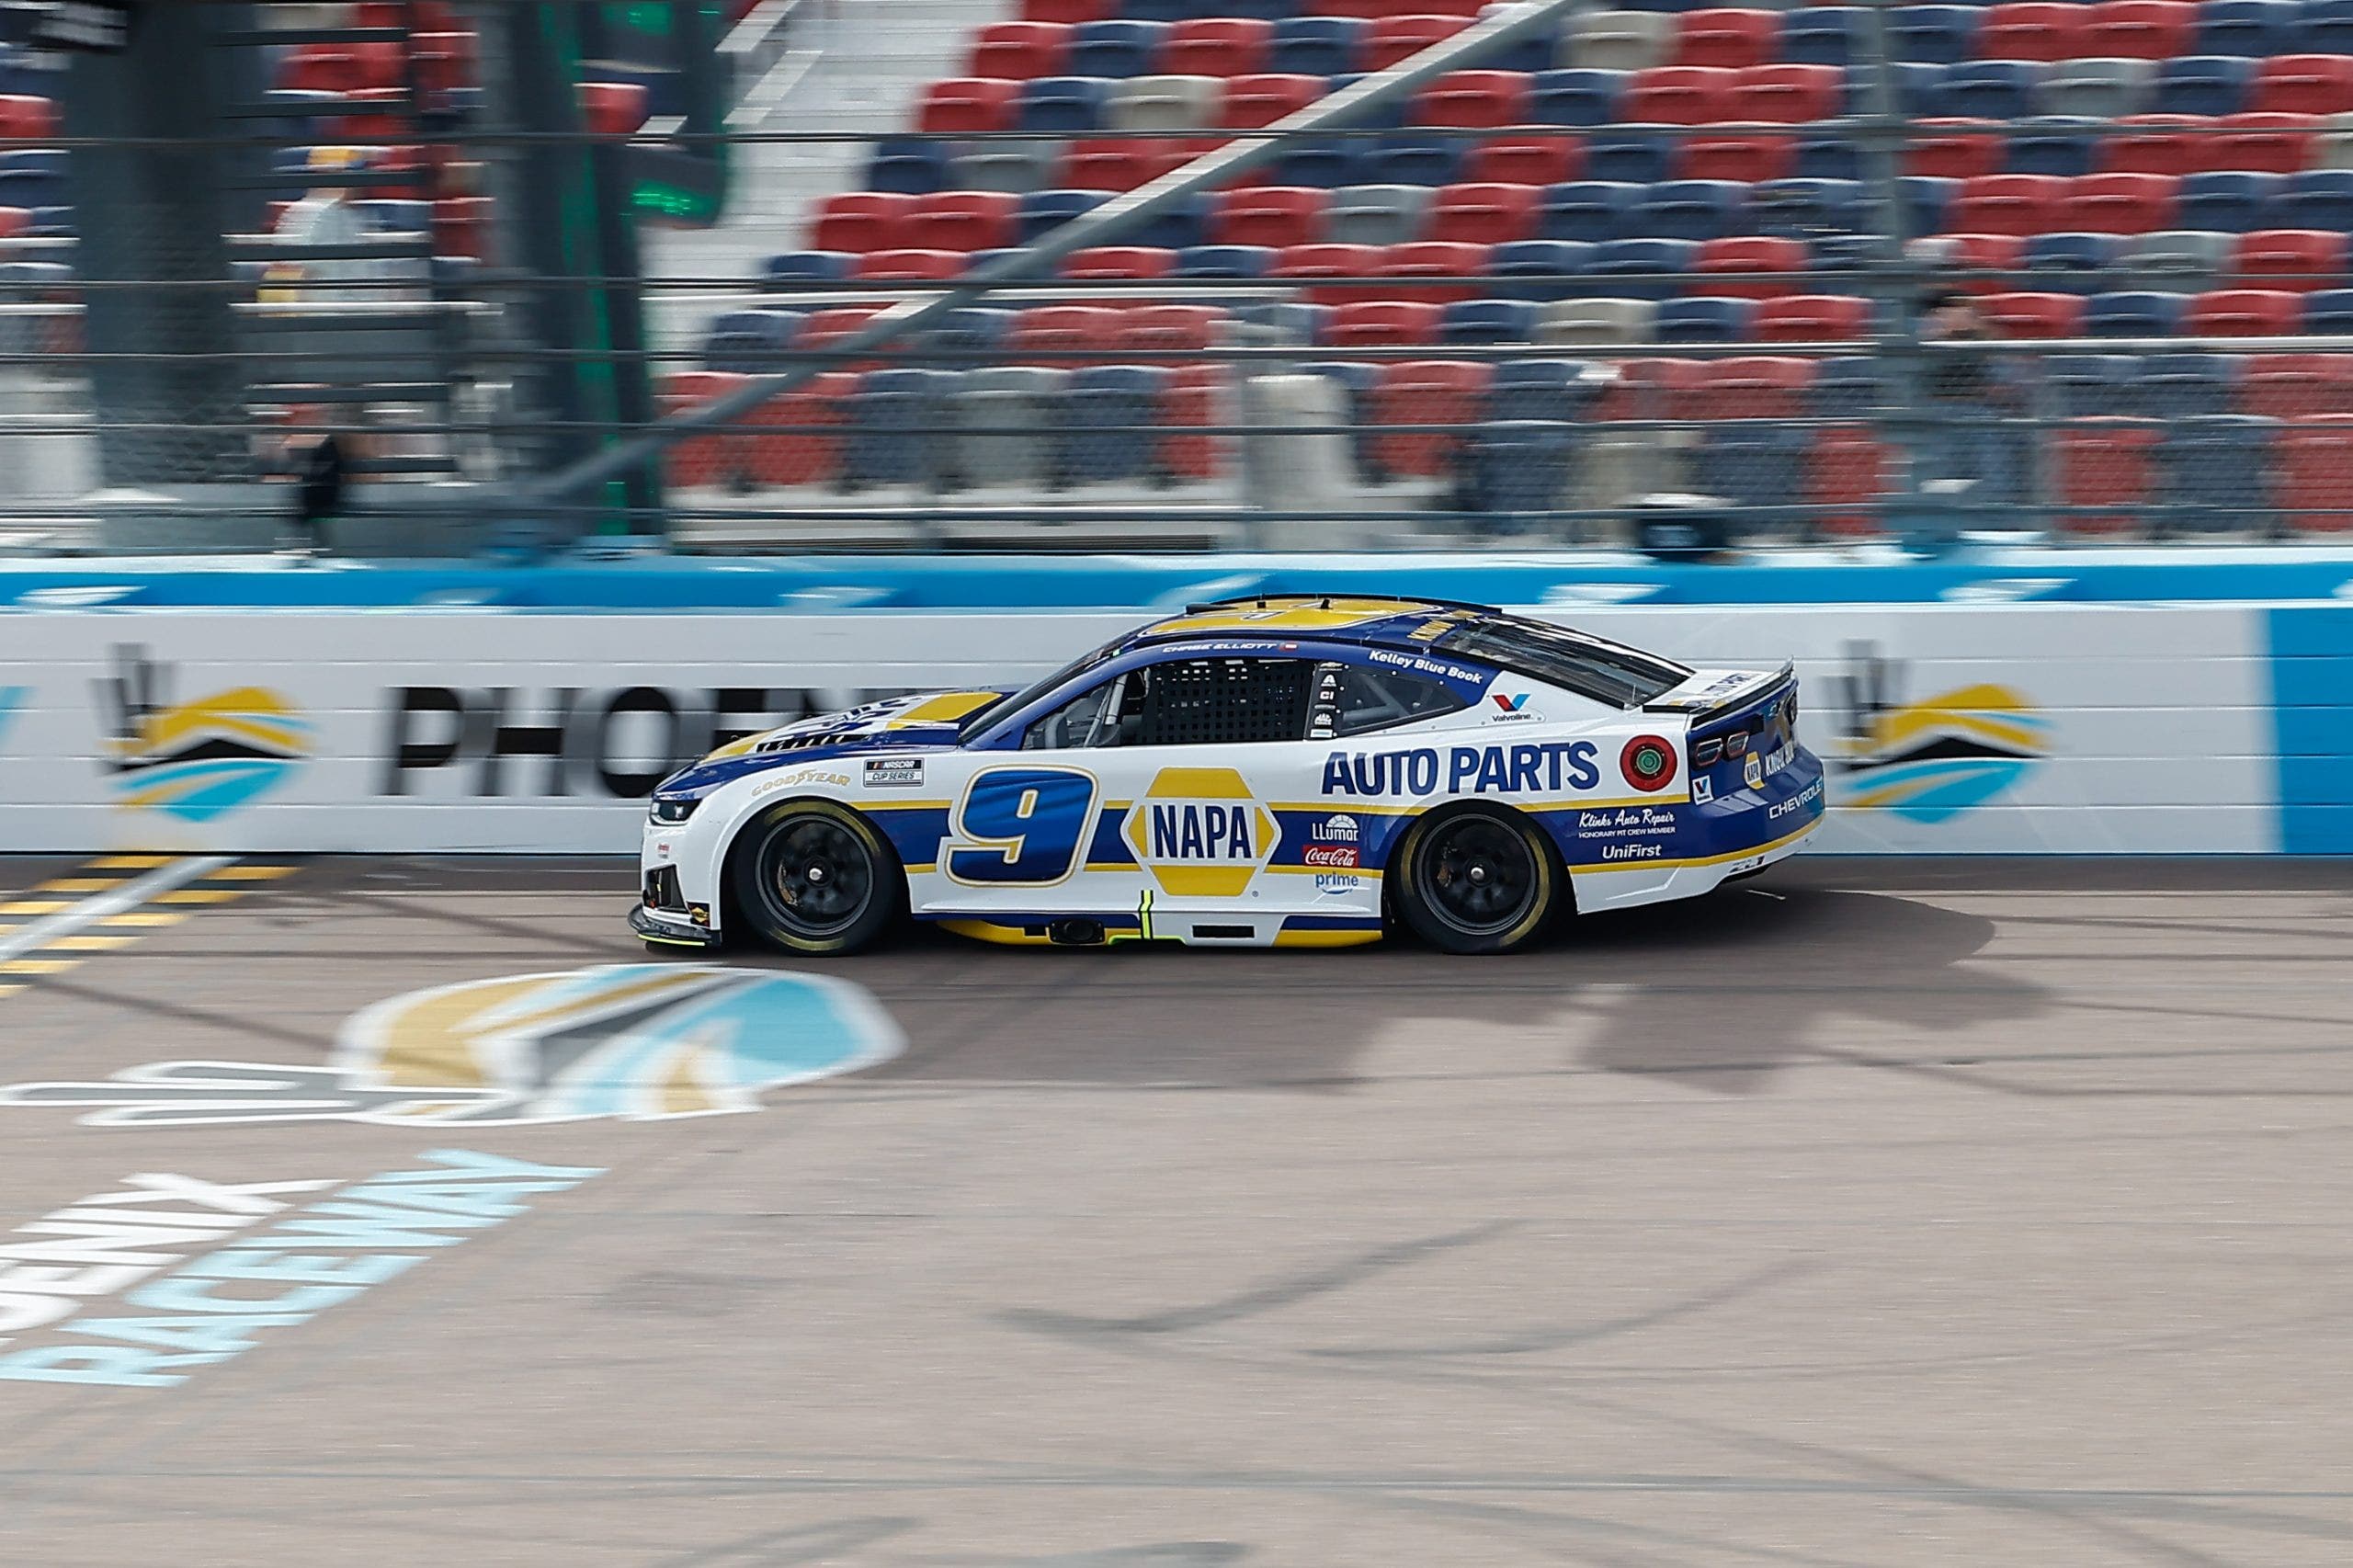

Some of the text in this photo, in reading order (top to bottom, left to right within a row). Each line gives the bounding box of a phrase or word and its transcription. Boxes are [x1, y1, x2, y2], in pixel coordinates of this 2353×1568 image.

[1369, 649, 1483, 684] Kelley Blue Book
[1492, 713, 1531, 722] Valvoline
[882, 761, 915, 769] NASCAR
[1321, 741, 1601, 796] AUTO PARTS
[751, 769, 851, 797] GOODYEAR
[872, 771, 915, 780] CUP SERIES
[1614, 809, 1641, 826] Auto
[1642, 808, 1676, 826] Repair
[945, 764, 1099, 889] 9
[1153, 804, 1252, 859] NAPA
[1312, 822, 1359, 841] LLumar
[1578, 830, 1616, 838] HONORARY
[1647, 826, 1676, 835] MEMBER
[1602, 844, 1663, 859] UniFirst
[1315, 870, 1359, 888] prime
[0, 1148, 611, 1388] RACEWAY
